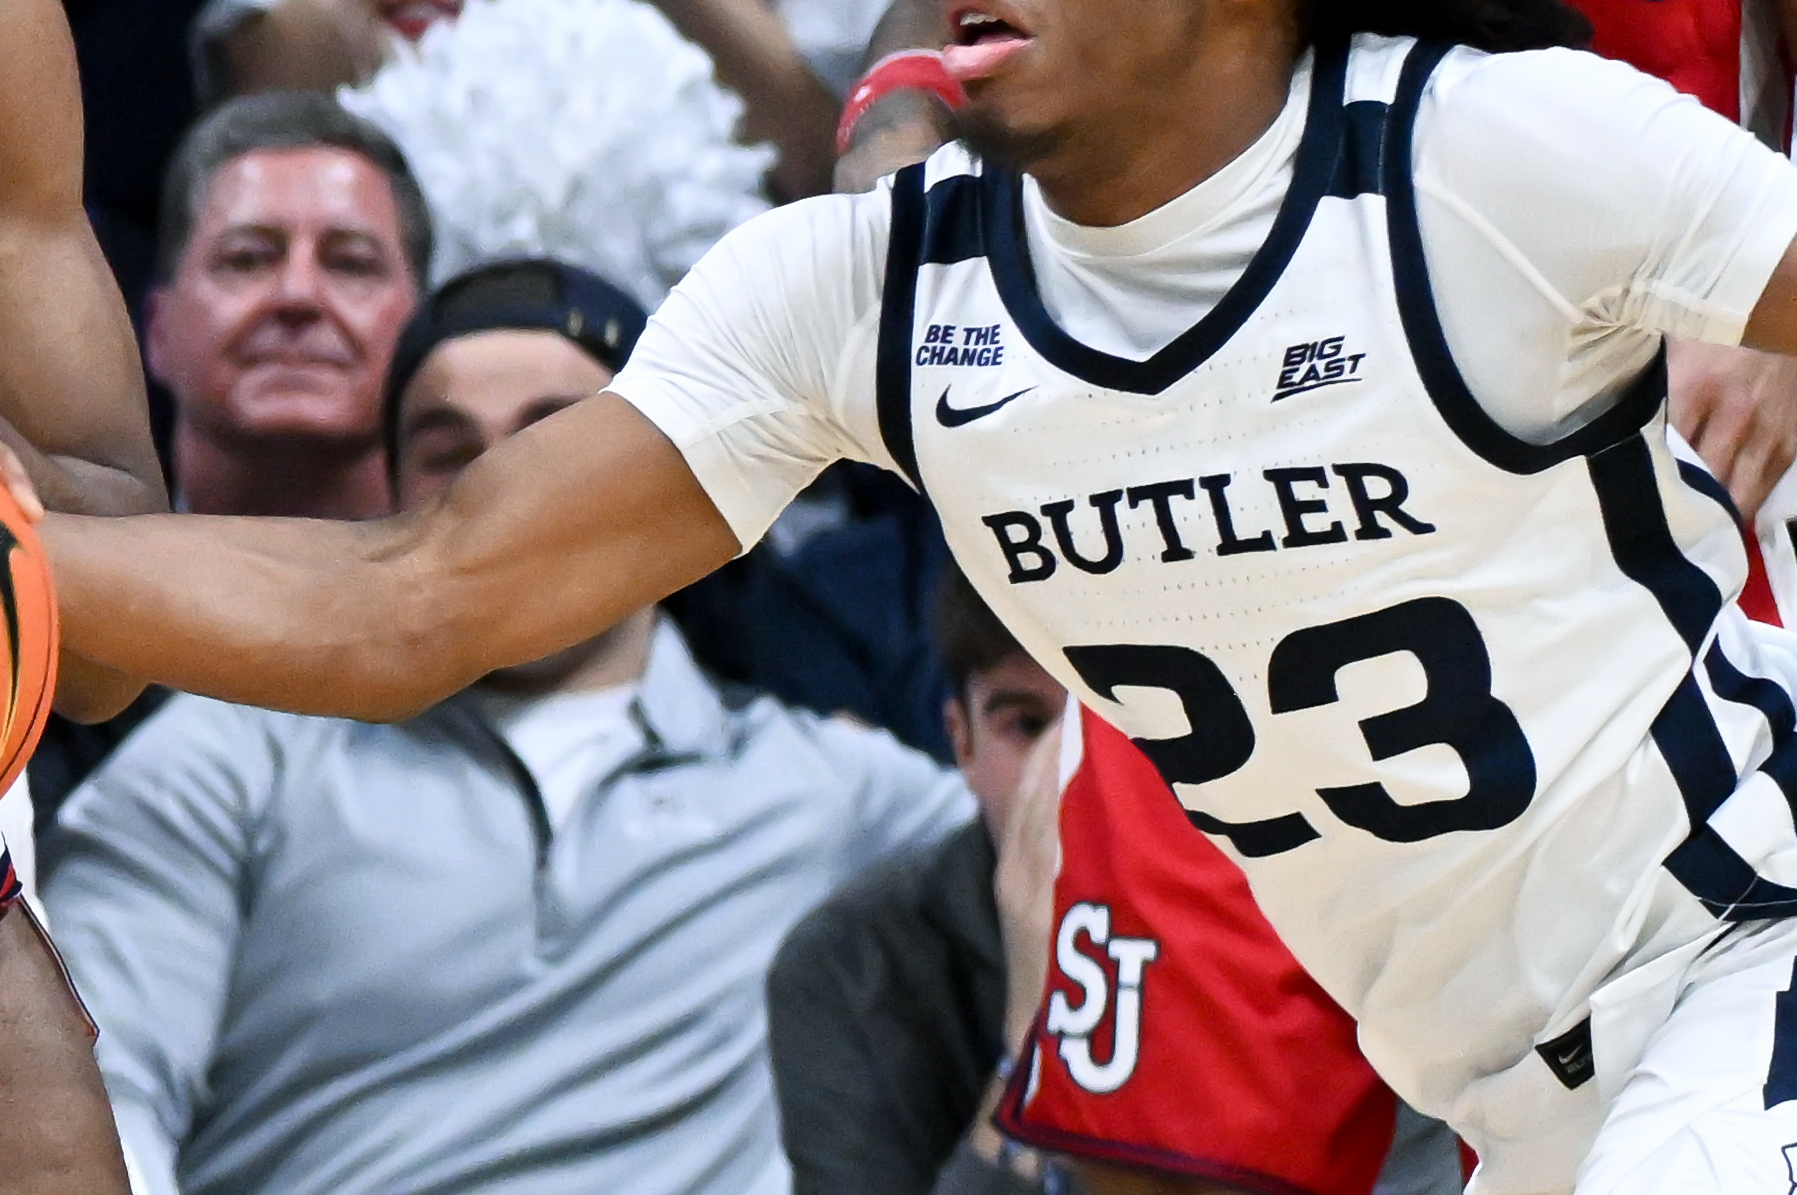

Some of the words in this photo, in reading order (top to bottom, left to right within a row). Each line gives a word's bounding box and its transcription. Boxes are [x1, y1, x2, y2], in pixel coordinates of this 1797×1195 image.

[924, 324, 956, 344] BE
[963, 324, 1001, 346] THE
[1283, 334, 1345, 368] BIG
[915, 345, 1004, 367] CHANGE
[1276, 352, 1366, 390] EAST
[982, 463, 1436, 584] BUTLER
[1063, 596, 1537, 858] 23
[1047, 902, 1158, 1093] SJ
